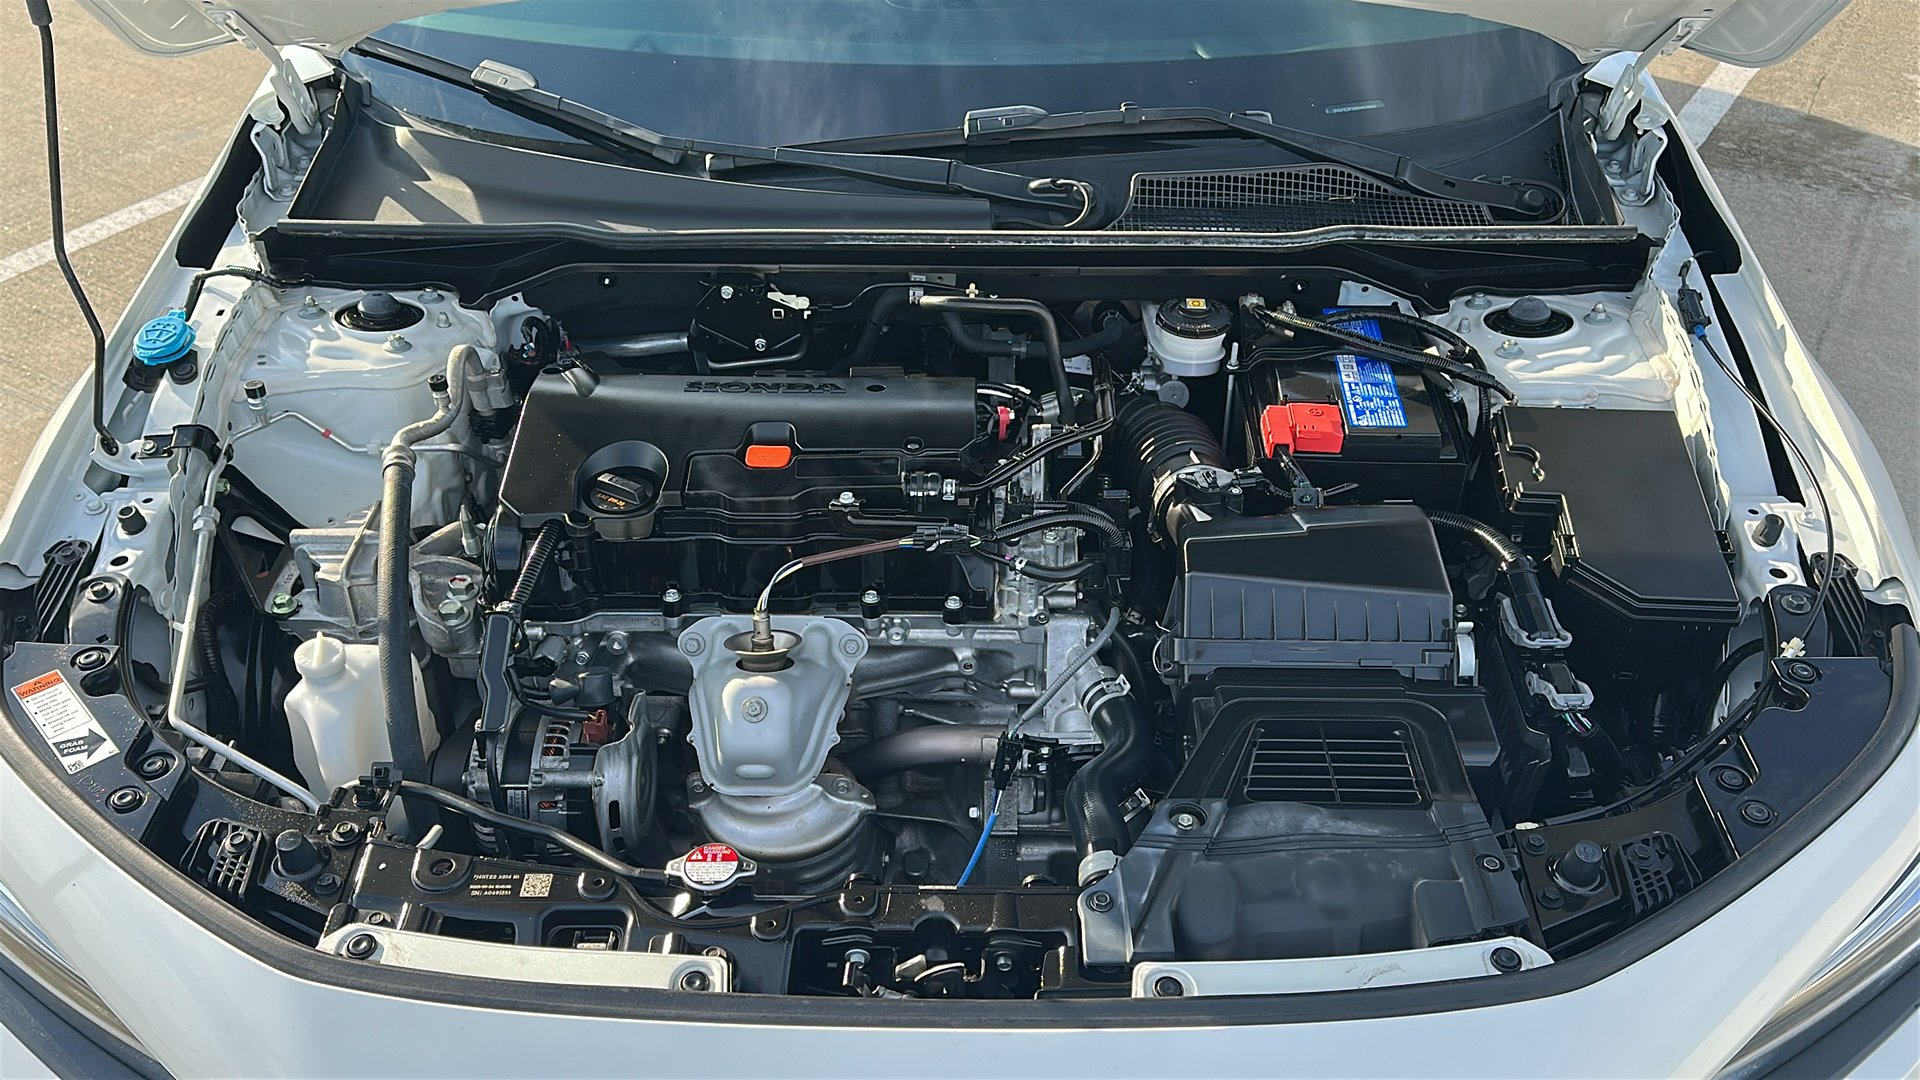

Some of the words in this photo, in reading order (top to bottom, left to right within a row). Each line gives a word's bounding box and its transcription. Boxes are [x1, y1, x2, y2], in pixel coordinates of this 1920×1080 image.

[684, 381, 847, 394] HONDA
[19, 678, 60, 697] WARNING
[59, 740, 84, 749] GRAB
[63, 745, 88, 754] FOAM
